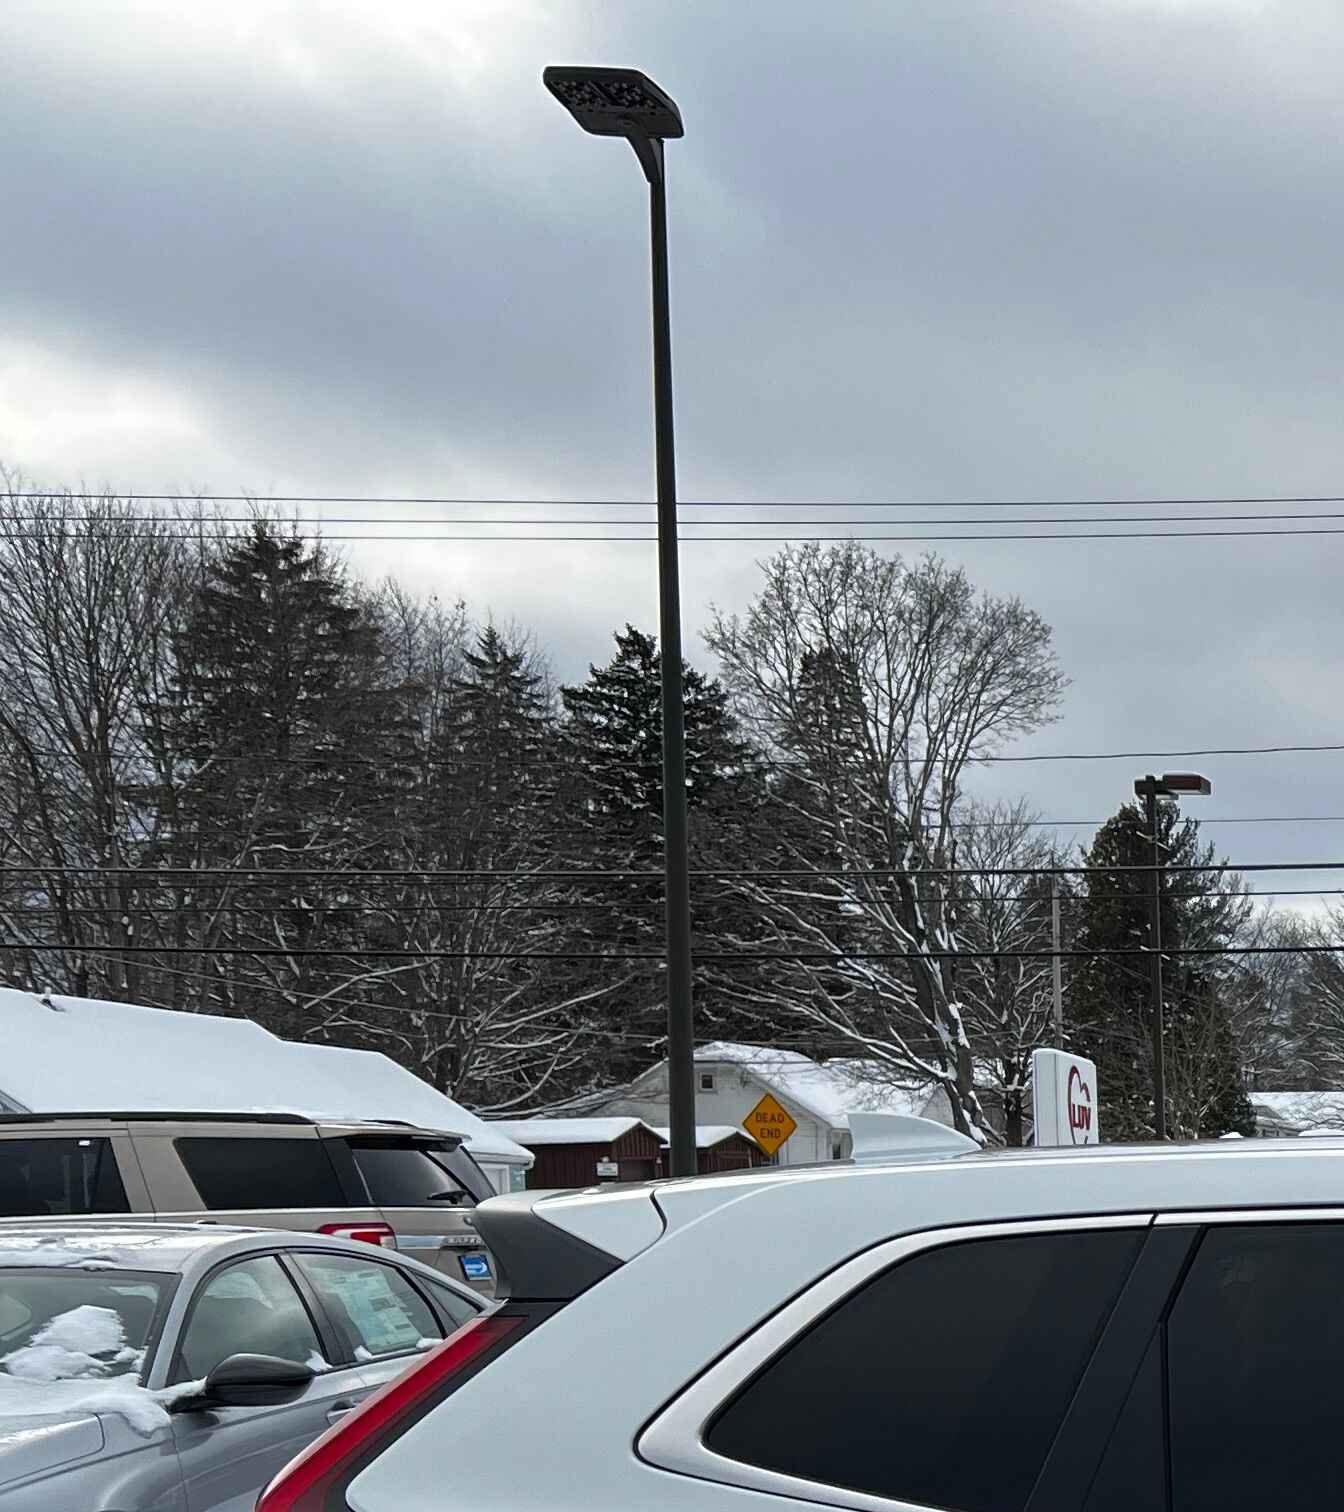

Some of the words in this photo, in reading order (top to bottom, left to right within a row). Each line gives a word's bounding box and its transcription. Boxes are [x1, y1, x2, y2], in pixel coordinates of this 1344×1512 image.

[755, 1111, 785, 1124] DEAD
[1072, 1103, 1092, 1131] LUV
[760, 1127, 781, 1139] END
